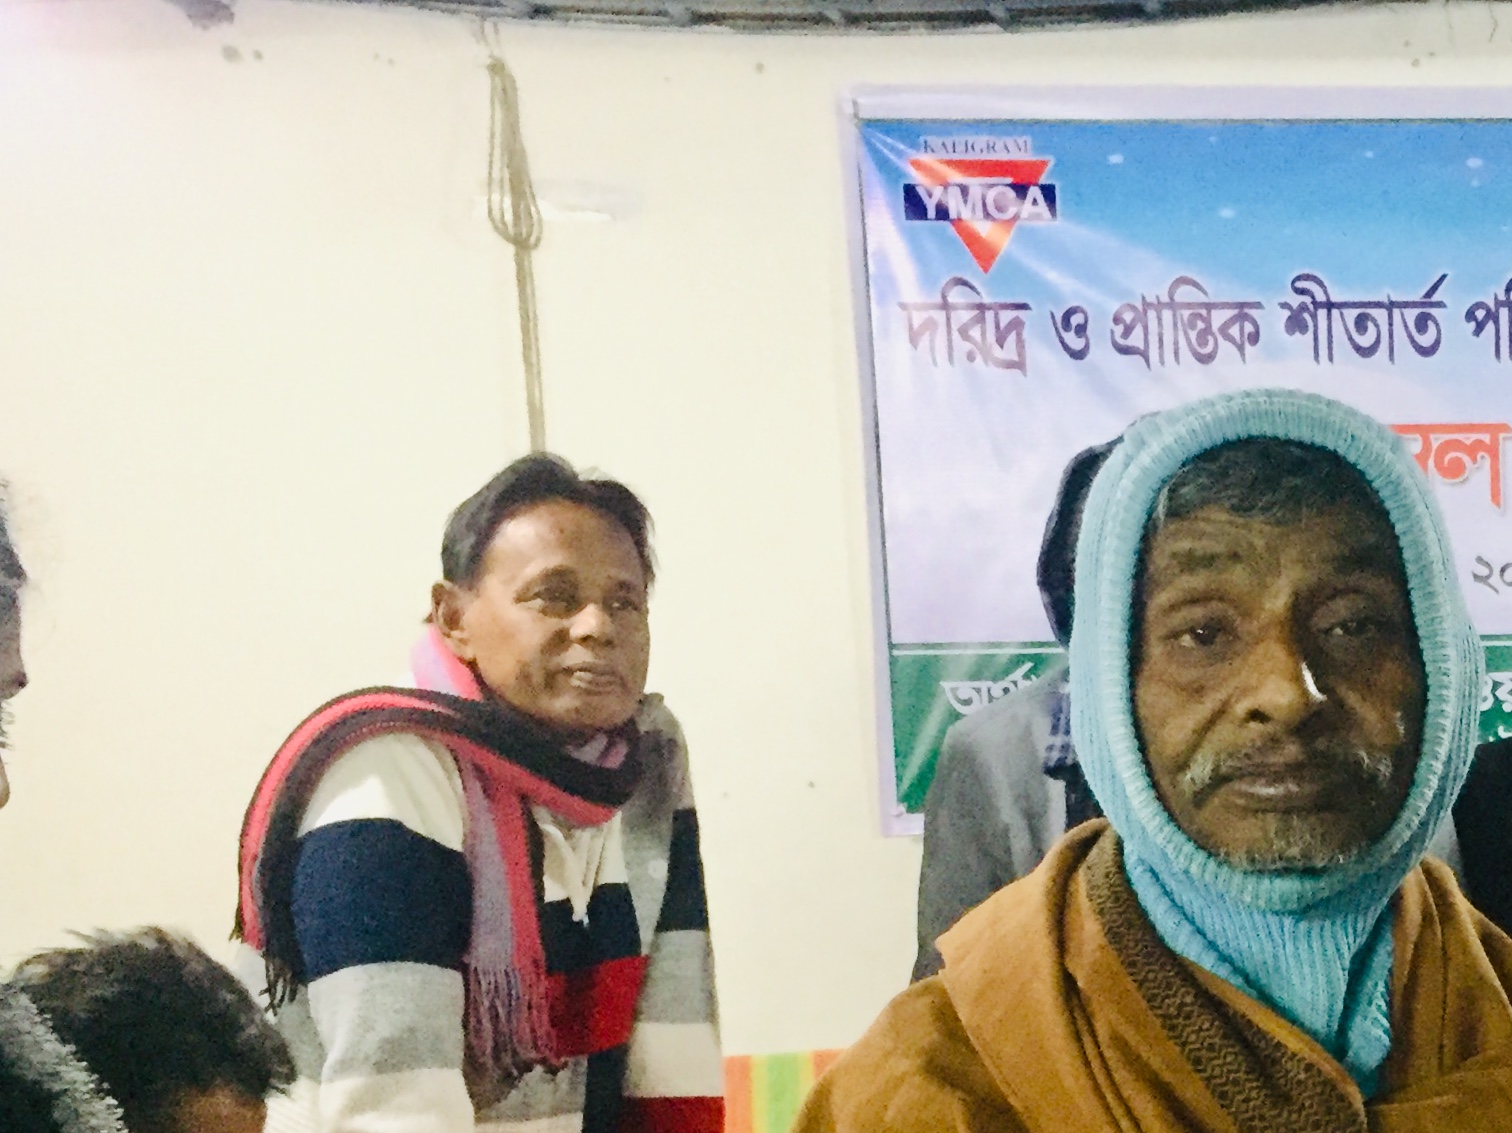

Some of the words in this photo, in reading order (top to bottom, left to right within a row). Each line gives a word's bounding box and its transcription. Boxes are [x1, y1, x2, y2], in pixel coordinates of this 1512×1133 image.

[923, 138, 1030, 154] KALIGRAM
[915, 184, 1052, 220] YMCA
[897, 276, 1032, 377] দরিদ্র
[1050, 304, 1091, 362] ও
[1110, 275, 1265, 371] প্রান্তিক
[1279, 272, 1448, 365] শীতার্ত
